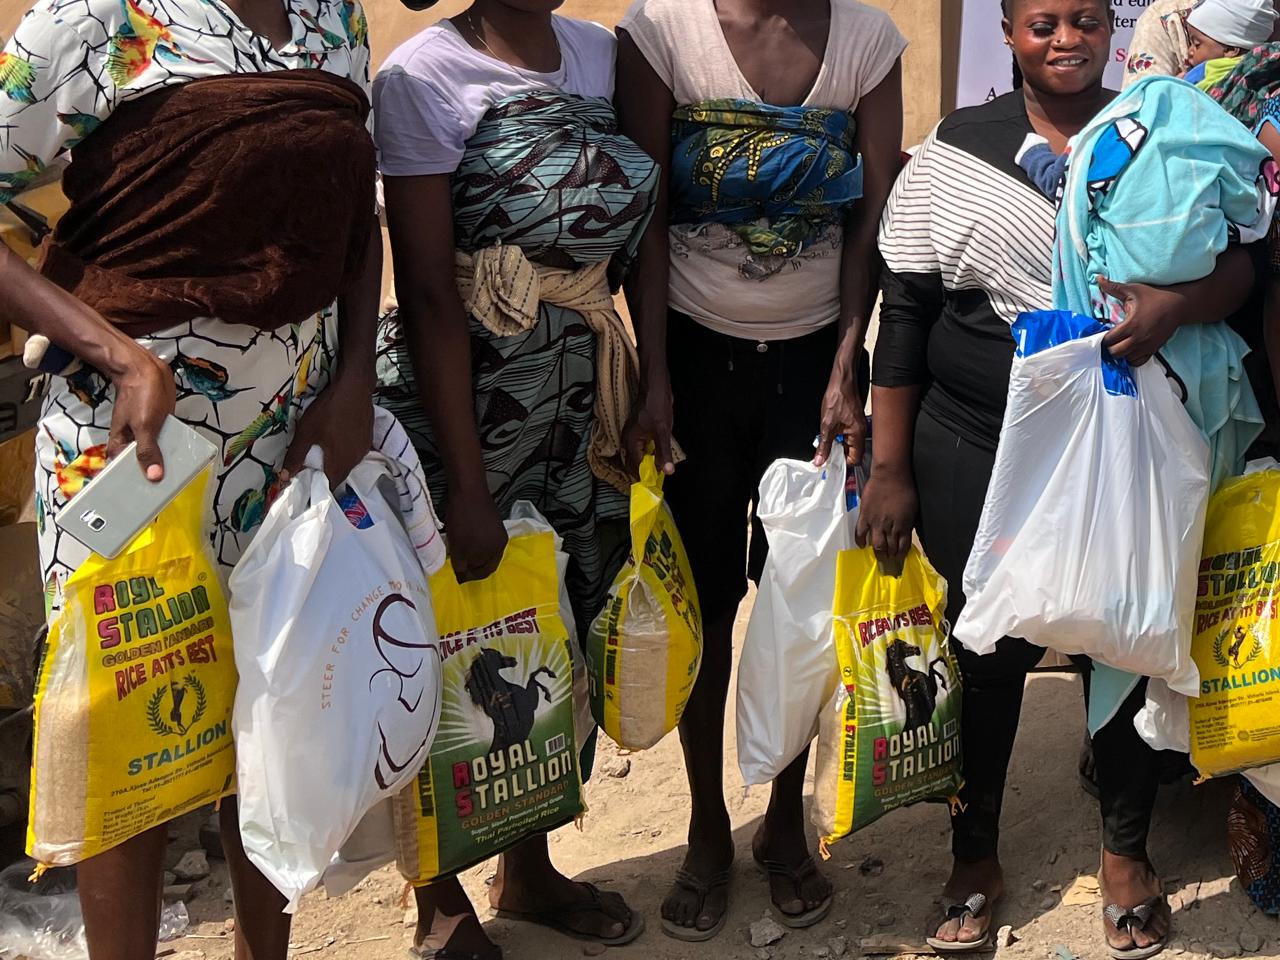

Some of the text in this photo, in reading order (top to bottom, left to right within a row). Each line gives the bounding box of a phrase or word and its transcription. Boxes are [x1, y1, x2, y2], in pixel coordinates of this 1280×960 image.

[910, 603, 933, 626] BES
[1256, 596, 1280, 620] BST
[102, 640, 162, 667] GOLDEN
[321, 585, 385, 709] STEER FOR CHANGE
[440, 630, 464, 662] ICE
[505, 608, 540, 634] BEST
[115, 663, 148, 701] RICE
[128, 719, 227, 777] STALLION
[453, 739, 538, 788] ROYAL
[872, 737, 960, 786] STALLION
[873, 722, 938, 761] ROYAL
[455, 750, 572, 817] STALLION
[461, 780, 569, 830] GOLDEN STANDARD
[475, 829, 496, 844] Thai
[540, 806, 560, 819] Rice
